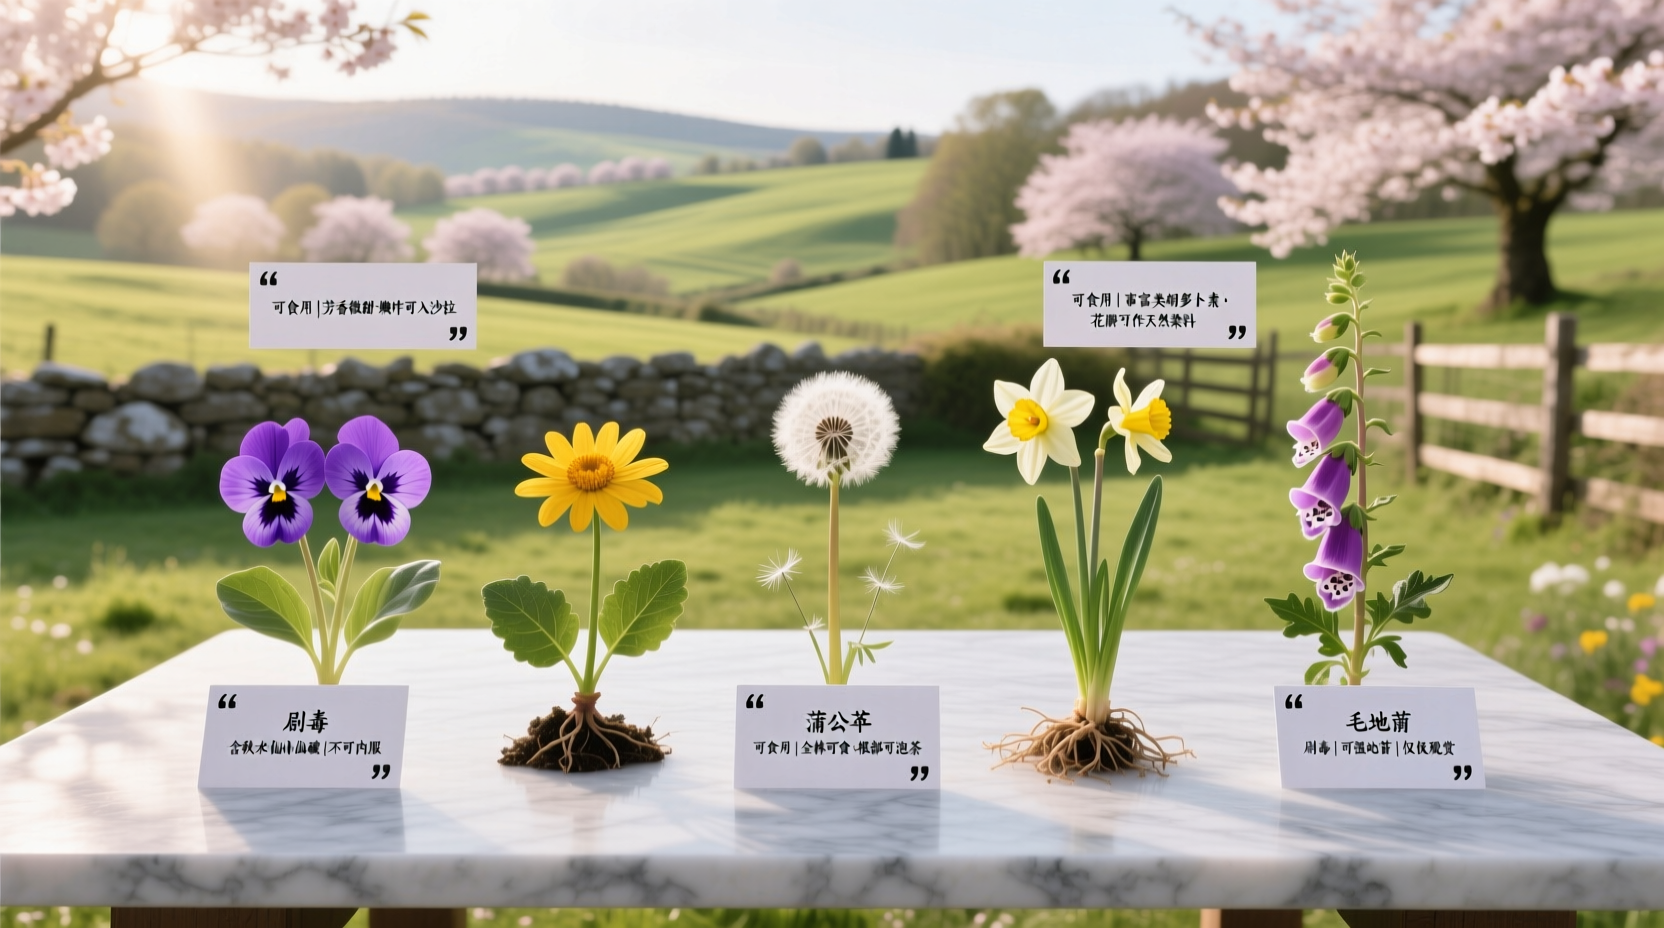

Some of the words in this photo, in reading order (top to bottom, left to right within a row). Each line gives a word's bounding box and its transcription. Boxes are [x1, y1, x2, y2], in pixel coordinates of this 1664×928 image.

[272, 299, 312, 316] 可食用
[1072, 292, 1111, 308] 可食用
[753, 740, 790, 755] 可食用
